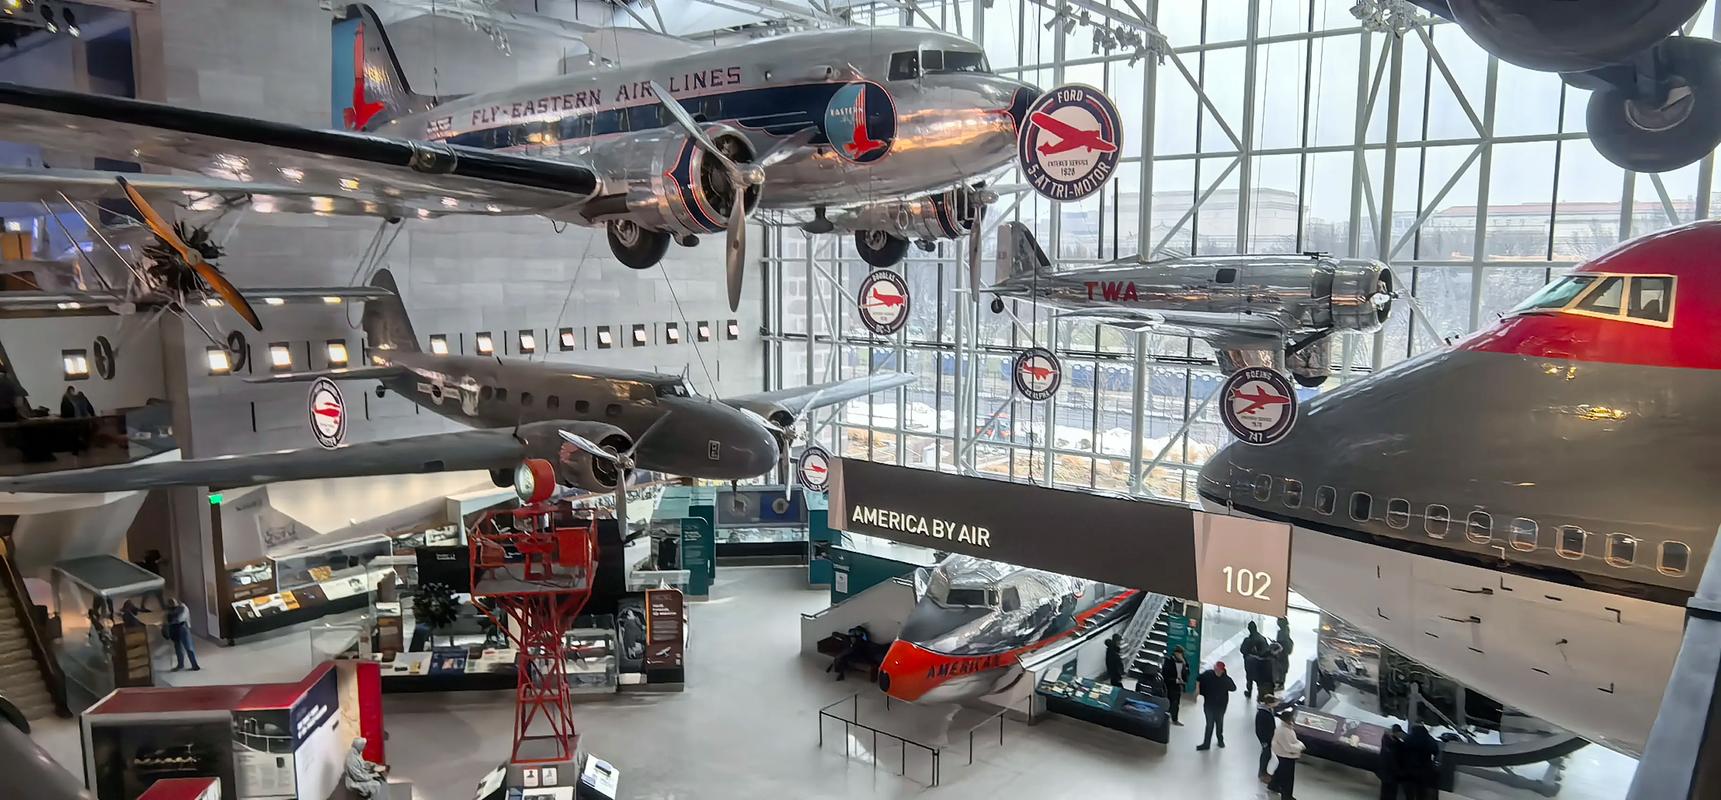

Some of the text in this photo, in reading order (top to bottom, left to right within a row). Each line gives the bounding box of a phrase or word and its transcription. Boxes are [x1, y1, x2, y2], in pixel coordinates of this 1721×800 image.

[511, 89, 601, 118] EASTERN
[616, 80, 652, 102] AIR
[670, 67, 741, 92] LINES
[1057, 89, 1083, 103] FORD
[830, 106, 864, 116] EASTERN
[1027, 161, 1111, 198] 5-AT TRI-MOTOR
[1083, 281, 1139, 302] TWA
[1245, 370, 1273, 380] BOEING
[1248, 432, 1263, 442] 747
[852, 505, 991, 547] AMERICA BY AIR
[1222, 566, 1272, 600] 102
